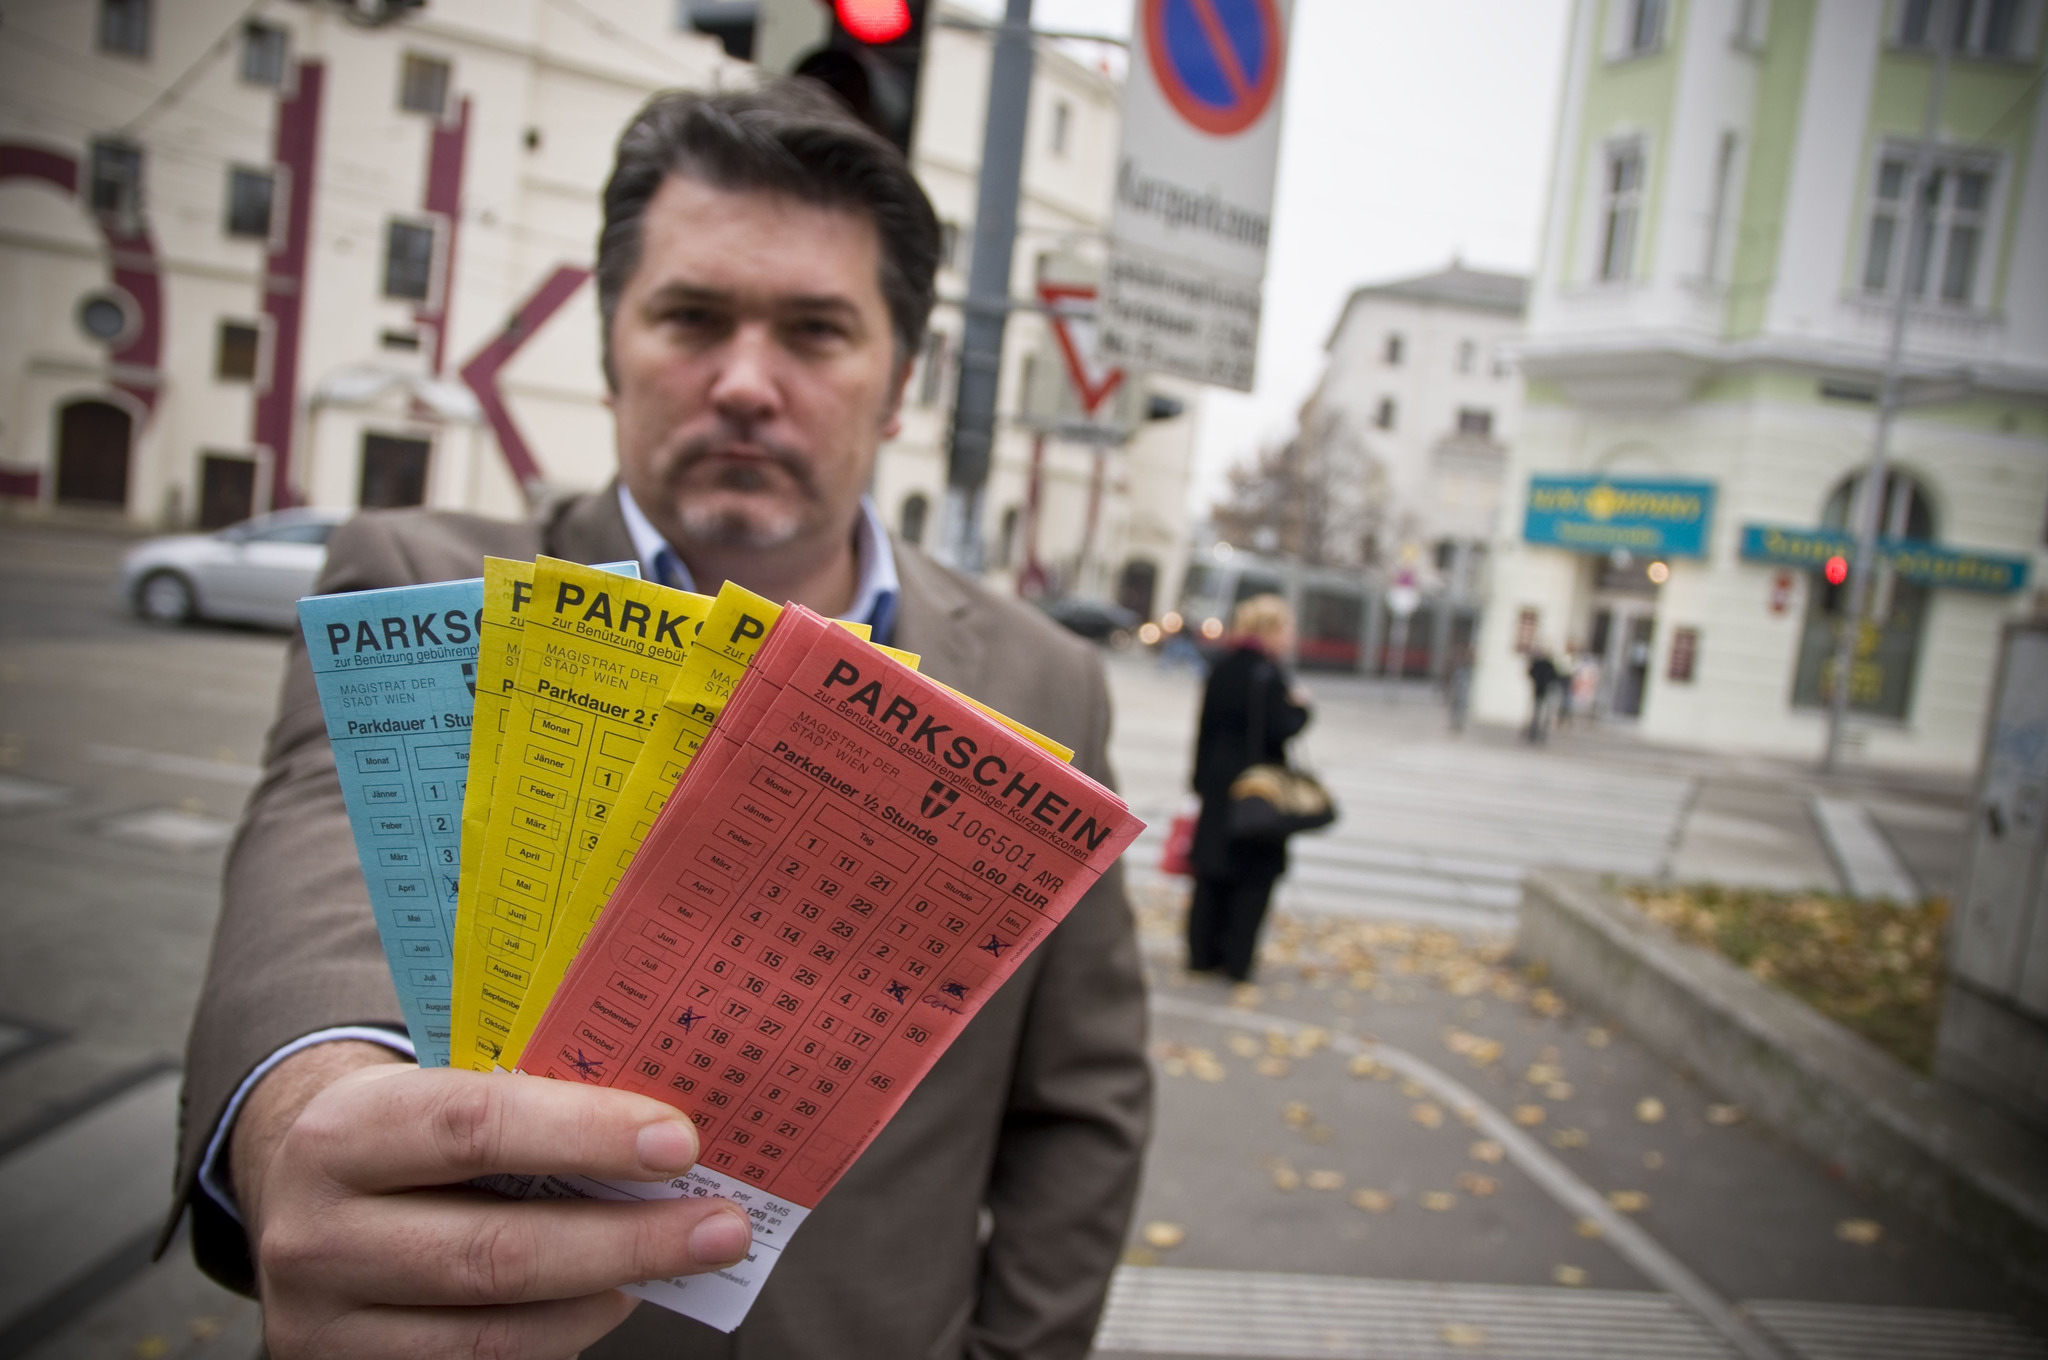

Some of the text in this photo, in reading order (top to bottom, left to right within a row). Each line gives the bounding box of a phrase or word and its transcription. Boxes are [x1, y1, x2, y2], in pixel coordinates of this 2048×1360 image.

[551, 616, 573, 631] zur
[576, 621, 645, 655] Benützung
[334, 657, 351, 668] zur
[354, 651, 413, 667] Benützung
[723, 645, 745, 660] zur
[546, 643, 626, 675] MAGISTRAT
[630, 669, 659, 685] DER
[543, 656, 630, 690] STADT WIEN
[340, 677, 436, 695] MAGISTRAT DER
[342, 692, 416, 708] STADT WIEN
[537, 678, 630, 719] Parkdauer
[633, 709, 646, 724] 2
[347, 717, 426, 735] Parkdauer
[430, 715, 439, 729] 1
[542, 719, 571, 735] Monat
[789, 722, 870, 774] STADT WIEN
[797, 711, 900, 778] MAGISTRAT DER
[366, 756, 390, 766] Monat
[454, 751, 470, 761] Tag
[533, 753, 565, 769] Jänner
[822, 658, 1111, 851] PARKSCHEIN
[603, 772, 612, 787] 1
[814, 689, 1089, 861] zur Benützung gebührenpflichtiger Kurzparkzonen
[371, 789, 398, 799] Jänner
[430, 784, 439, 799] 1
[530, 785, 555, 800] Feber
[764, 777, 792, 797] Monat
[772, 741, 860, 799] Parkdauer
[881, 805, 939, 846] Stunde
[594, 804, 606, 818] 2
[743, 803, 774, 824] Jänner
[381, 821, 402, 830] Feber
[436, 817, 447, 831] 2
[525, 817, 547, 831] März
[727, 829, 752, 847] Feber
[807, 837, 818, 850] 1
[859, 832, 875, 847] Tag
[390, 852, 409, 861] März
[443, 849, 454, 863] 3
[519, 848, 541, 861] April
[947, 811, 1064, 894] 106501 AYR
[710, 855, 732, 871] März
[785, 862, 799, 875] 2
[838, 856, 856, 872] 11
[398, 883, 416, 893] April
[516, 879, 532, 891] Mai
[692, 880, 714, 896] April
[821, 879, 838, 896] 12
[869, 875, 891, 892] 21
[972, 860, 1049, 910] 0,60 EUR
[767, 886, 781, 899] 3
[944, 882, 973, 902] Stunde
[677, 906, 693, 919] Mai
[801, 903, 819, 919] 13
[850, 898, 873, 916] 22
[915, 900, 929, 913] 0
[407, 914, 421, 923] Mai
[508, 909, 527, 921] Juni
[750, 911, 762, 923] 4
[831, 921, 854, 938] 23
[898, 922, 908, 935] 1
[945, 916, 965, 933] 12
[1005, 916, 1022, 931] Min.
[657, 932, 678, 946] Juni
[730, 934, 745, 948] 5
[782, 926, 801, 943] 14
[414, 944, 430, 953] Juni
[504, 939, 520, 950] Juli
[876, 945, 890, 958] 2
[926, 939, 945, 955] 13
[764, 951, 783, 968] 15
[813, 945, 835, 961] 24
[641, 958, 659, 972] Juli
[713, 960, 726, 974] 6
[907, 960, 926, 977] 14
[423, 973, 437, 982] Juli
[493, 964, 523, 982] August
[794, 968, 818, 986] 25
[857, 968, 871, 981] 3
[617, 980, 648, 1001] August
[696, 986, 710, 998] 7
[745, 976, 765, 993] 16
[776, 994, 799, 1012] 26
[840, 993, 853, 1005] 4
[594, 1001, 637, 1030] September
[727, 1002, 748, 1018] 17
[869, 1007, 888, 1024] 16
[759, 1020, 782, 1035] 27
[821, 1016, 835, 1029] 5
[582, 1029, 615, 1052] Oktober
[710, 1028, 729, 1045] 18
[852, 1031, 871, 1046] 17
[906, 1027, 927, 1043] 30
[660, 1037, 674, 1050] 9
[803, 1042, 816, 1054] 6
[692, 1052, 711, 1068] 19
[741, 1044, 763, 1061] 28
[641, 1060, 660, 1077] 10
[786, 1065, 800, 1076] 7
[834, 1056, 852, 1071] 18
[724, 1068, 745, 1084] 29
[870, 1075, 891, 1090] 45
[672, 1076, 695, 1092] 20
[815, 1079, 834, 1094] 19
[707, 1091, 728, 1107] 30
[768, 1088, 781, 1101] 8
[751, 1110, 763, 1122] 9
[795, 1101, 817, 1116] 20
[691, 1114, 710, 1128] 31
[731, 1129, 750, 1145] 10
[777, 1122, 798, 1137] 21
[715, 1152, 732, 1166] 11
[760, 1144, 782, 1159] 22
[743, 1165, 765, 1180] 23
[670, 1178, 690, 1193] (30,
[746, 1207, 767, 1221] 120)
[767, 1217, 782, 1226] an
[732, 1190, 753, 1202] per
[763, 1201, 791, 1217] SMS
